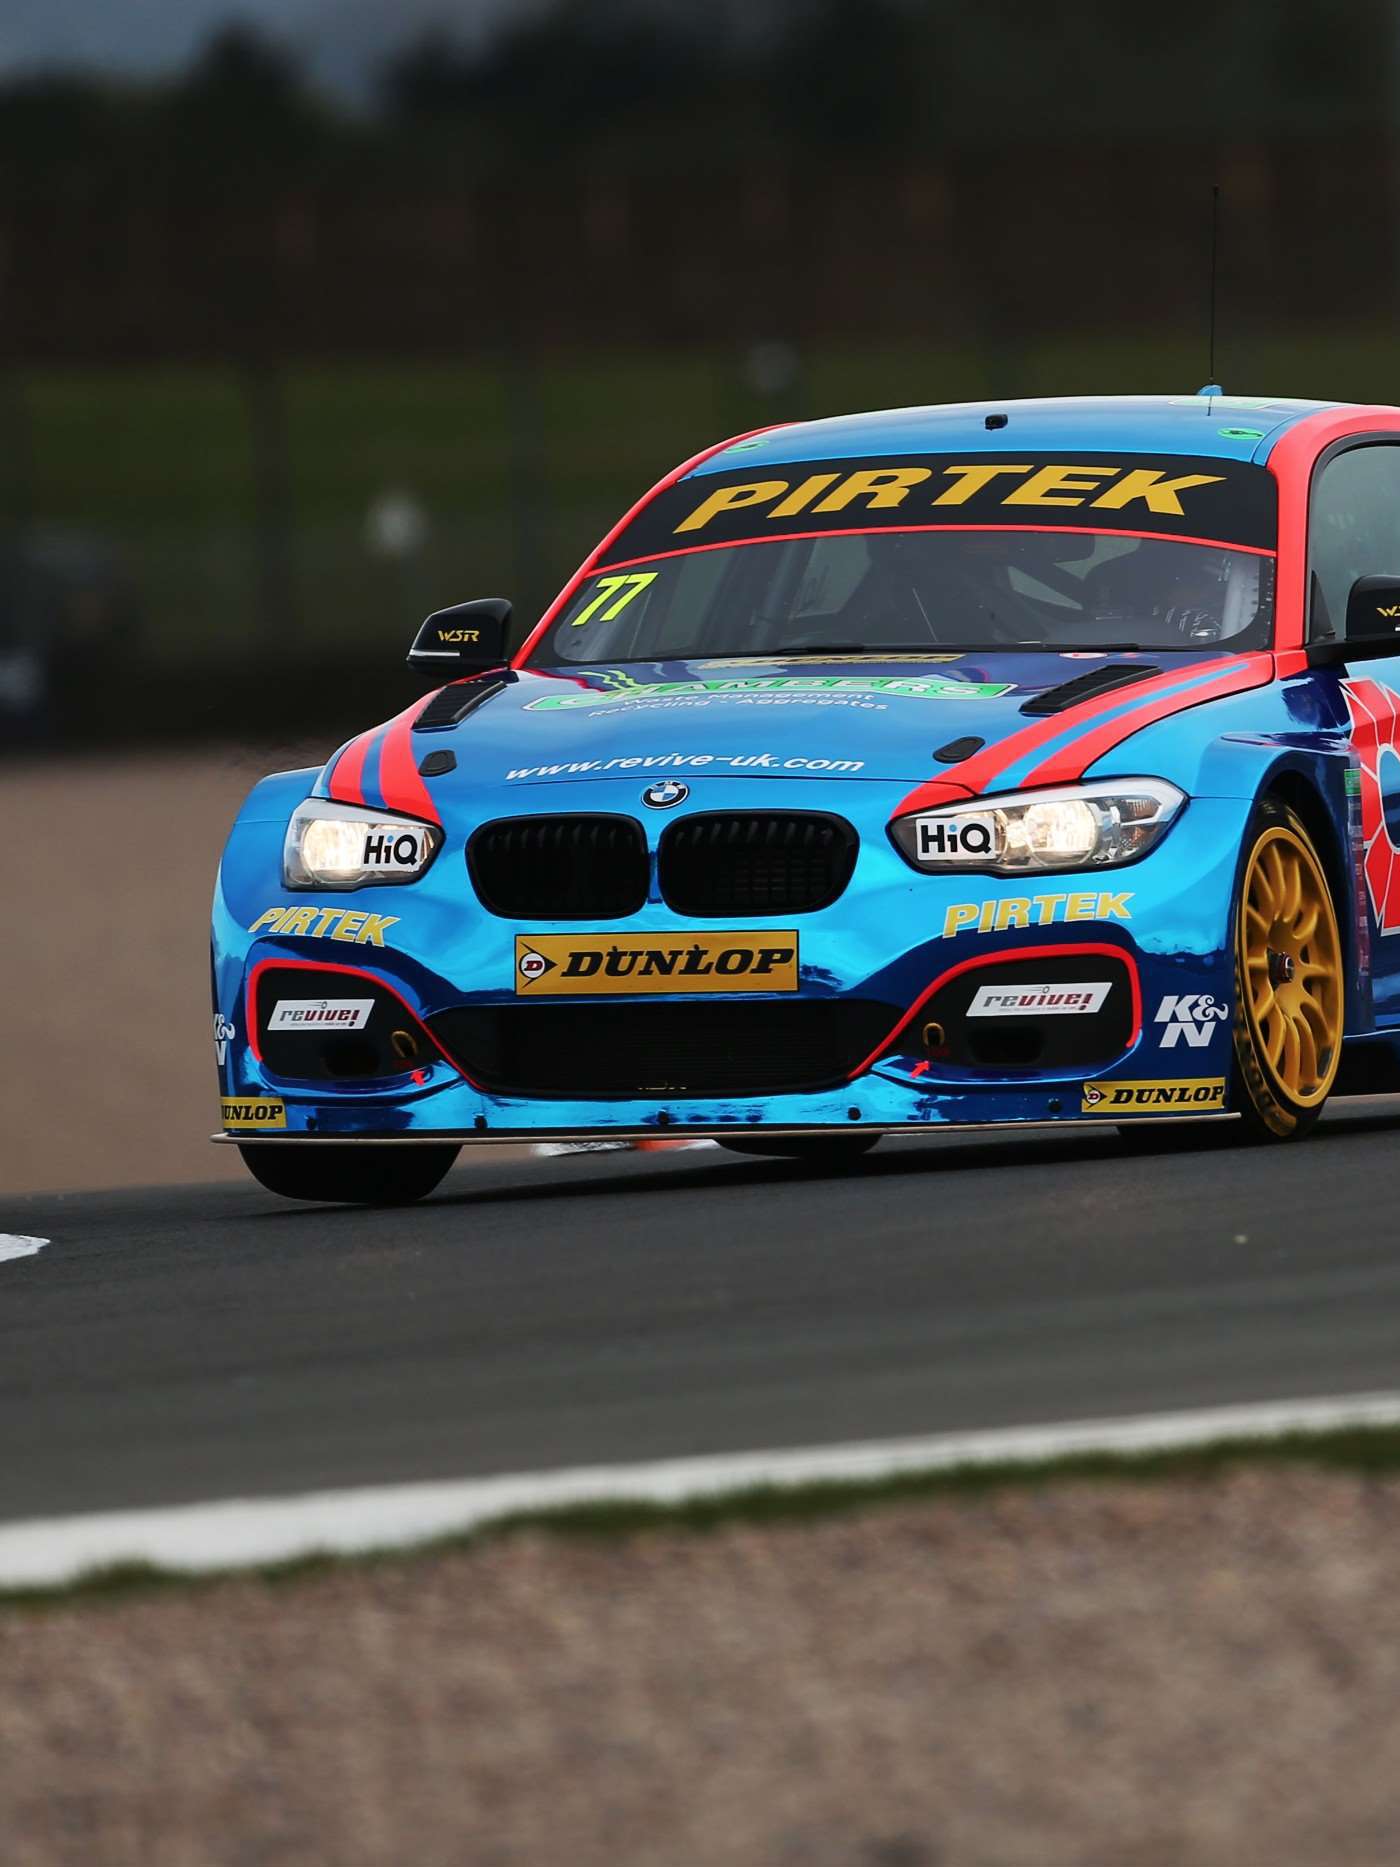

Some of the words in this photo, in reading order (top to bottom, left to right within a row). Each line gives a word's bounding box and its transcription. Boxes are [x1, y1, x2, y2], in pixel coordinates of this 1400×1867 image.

[673, 464, 1227, 534] PIRTEK
[572, 571, 658, 626] 77
[437, 629, 481, 642] WSR
[505, 752, 865, 780] www.revive-uk.com
[363, 834, 418, 866] HiQ
[920, 823, 992, 854] HiQ
[248, 906, 400, 948] PIRTEK
[942, 891, 1137, 939] PIRTEK
[560, 948, 795, 978] DUNLOP
[1109, 1085, 1224, 1105] DUNLOP
